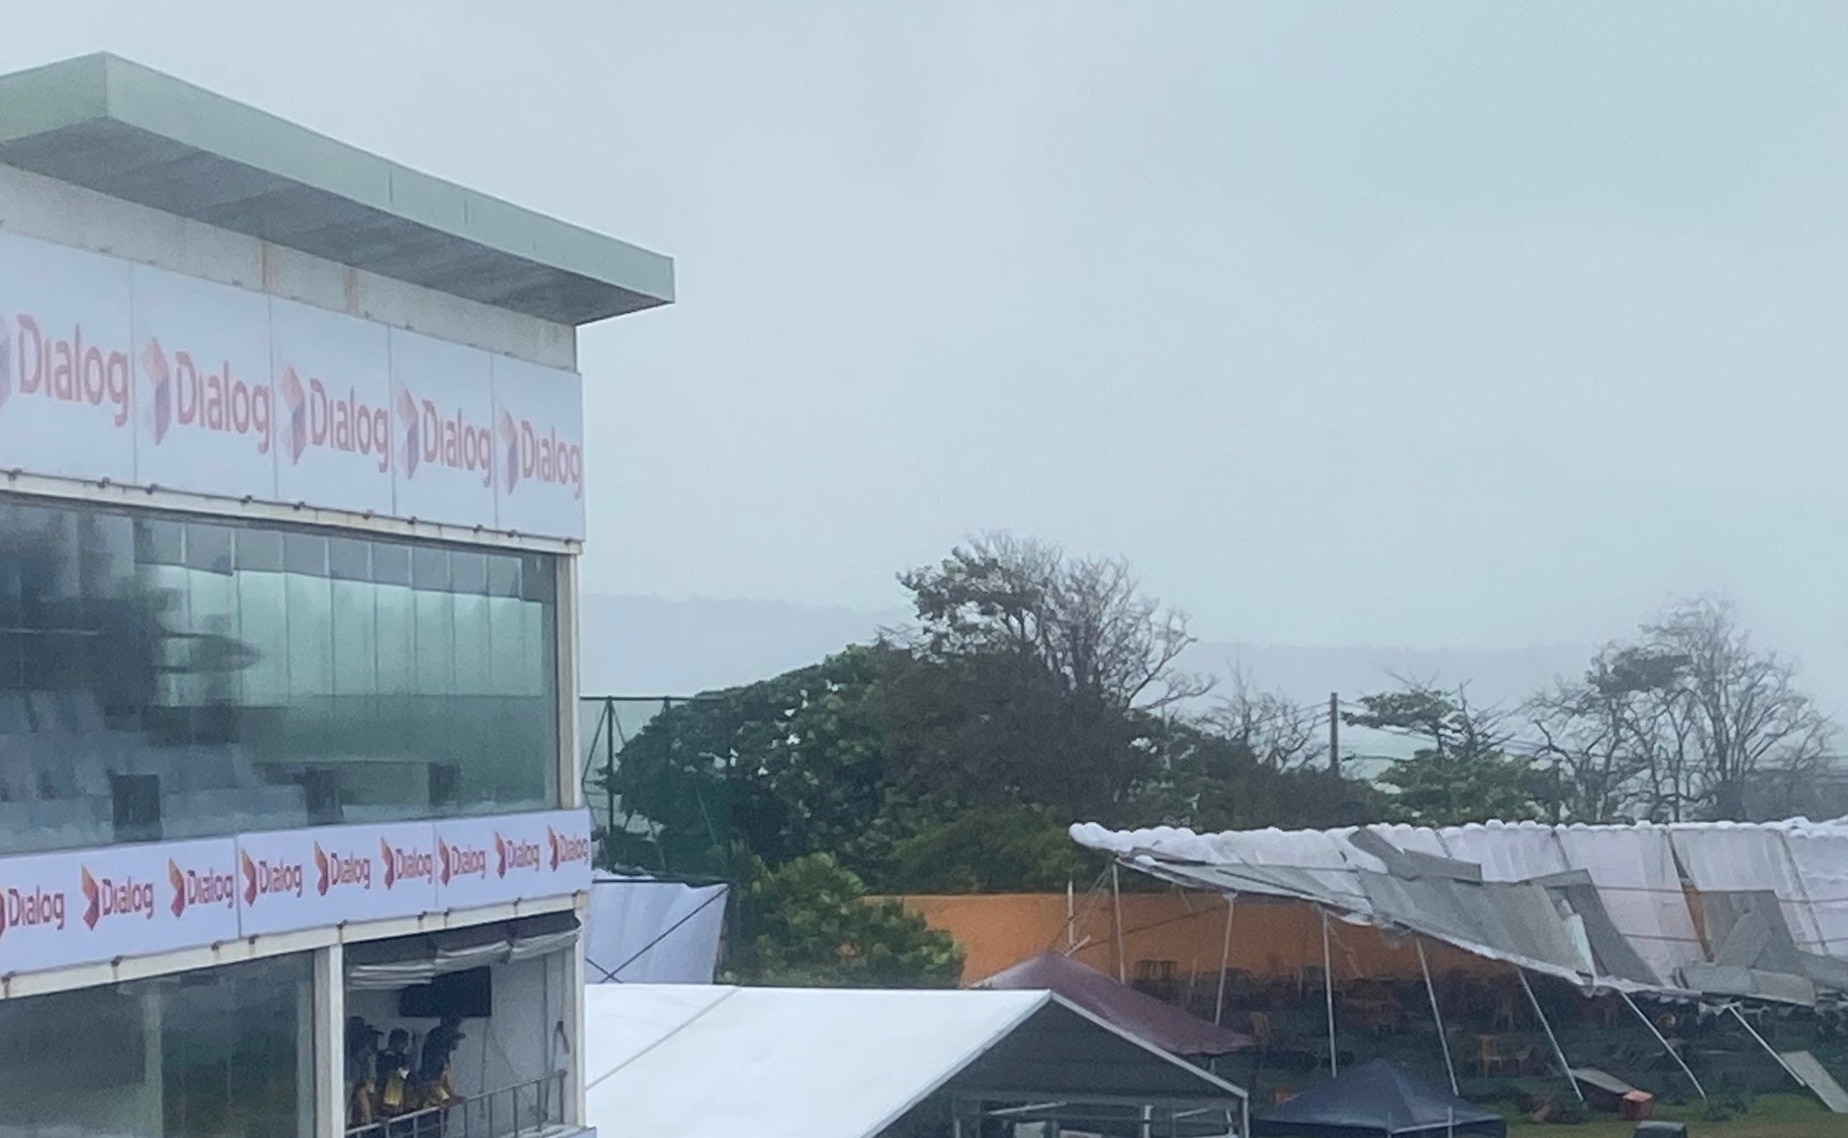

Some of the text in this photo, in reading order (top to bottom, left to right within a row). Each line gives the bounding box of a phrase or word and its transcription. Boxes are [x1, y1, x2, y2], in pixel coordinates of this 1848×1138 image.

[17, 314, 129, 427] Dialog
[176, 350, 269, 453] Dialog
[309, 378, 388, 473] Dialog
[422, 400, 491, 487] Dialog
[520, 420, 581, 499] Dialog
[396, 846, 433, 884] Dialog
[452, 845, 486, 879] Dialog
[507, 839, 540, 872] Dialog
[559, 834, 588, 865] Dialog
[187, 868, 234, 908] Dialog
[259, 858, 302, 898] Dialog
[331, 852, 371, 890] Dialog
[8, 885, 65, 930] Dialog
[102, 876, 153, 919] Dialog
